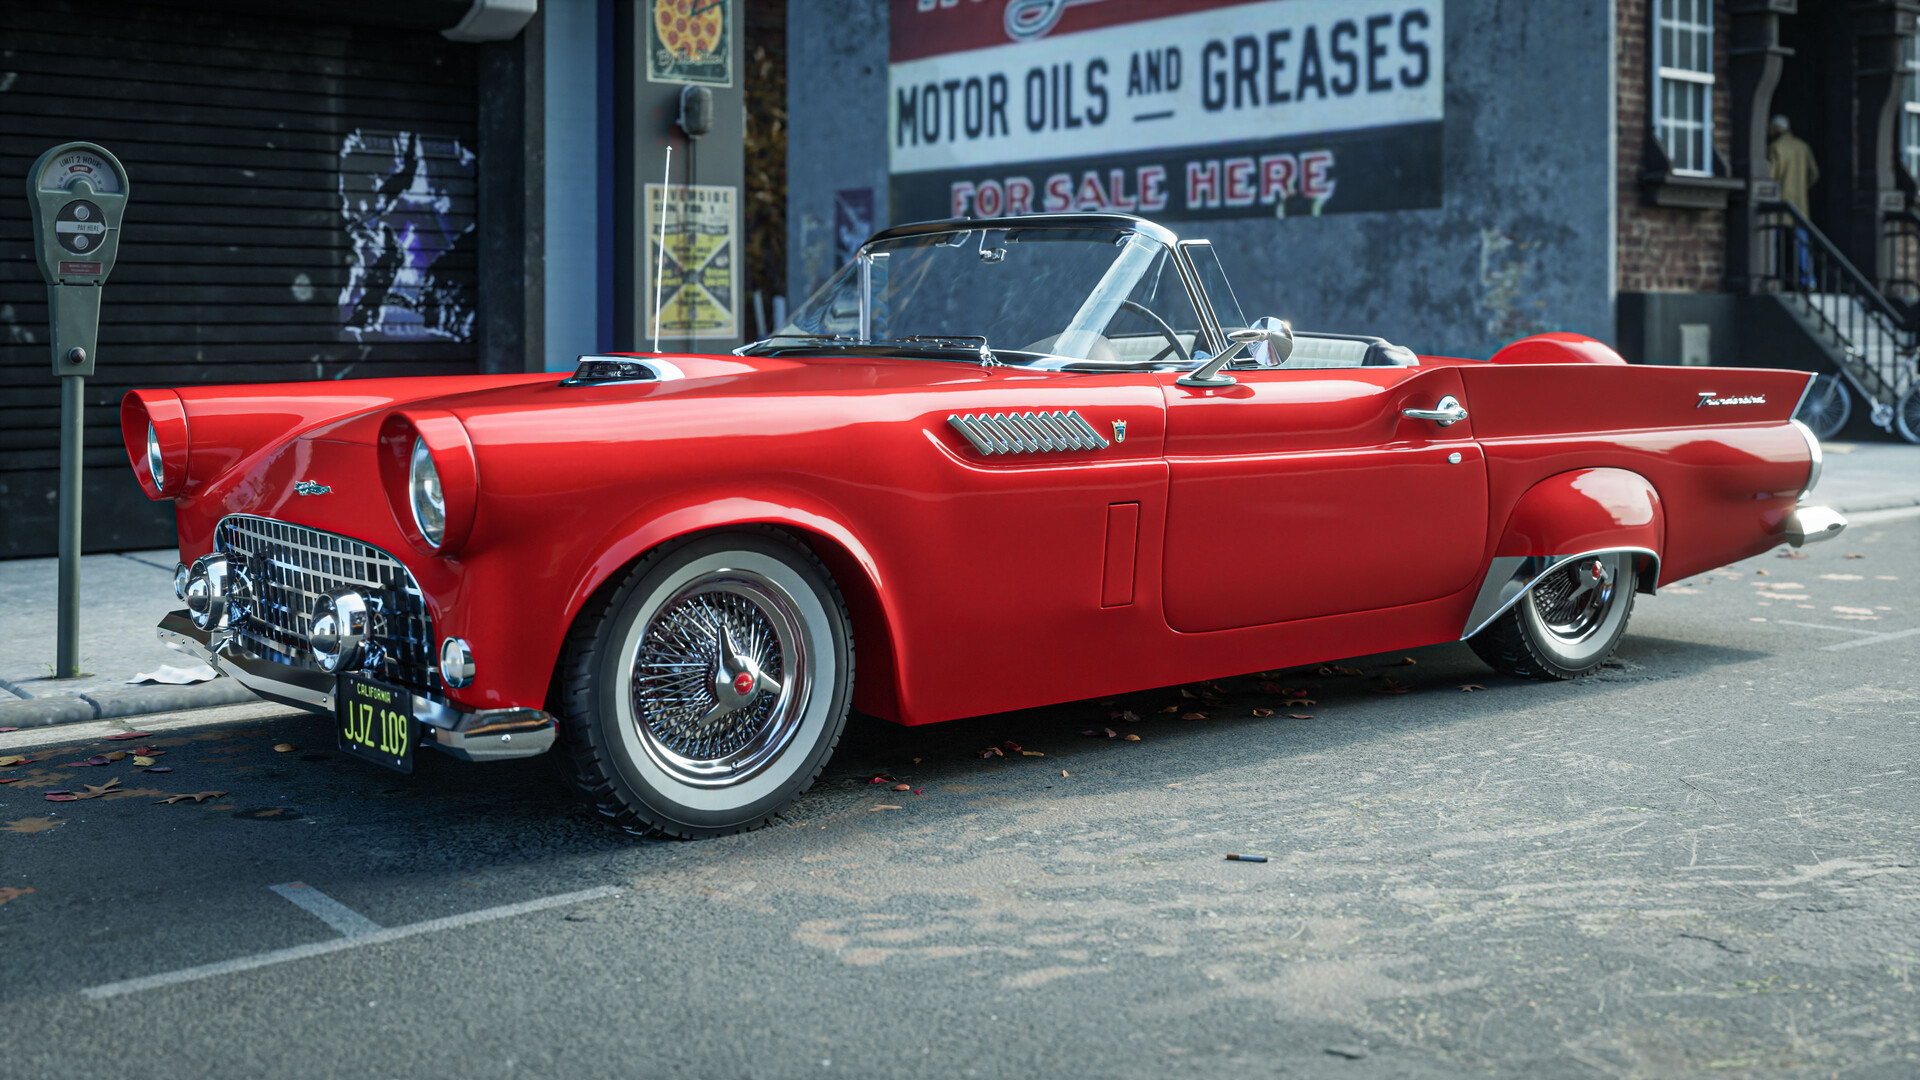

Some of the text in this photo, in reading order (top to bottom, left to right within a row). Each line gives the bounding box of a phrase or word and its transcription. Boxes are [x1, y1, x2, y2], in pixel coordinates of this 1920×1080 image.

[897, 9, 1430, 148] MOTOR OILS AND GREASES
[59, 155, 103, 170] LIMIT 2 HOURS
[952, 150, 1337, 219] FOR SALE HERE
[653, 189, 728, 204] RVERSIDE
[87, 224, 99, 232] HERE
[357, 682, 391, 704] CALIFORNIA
[344, 700, 408, 757] JJZ 109
